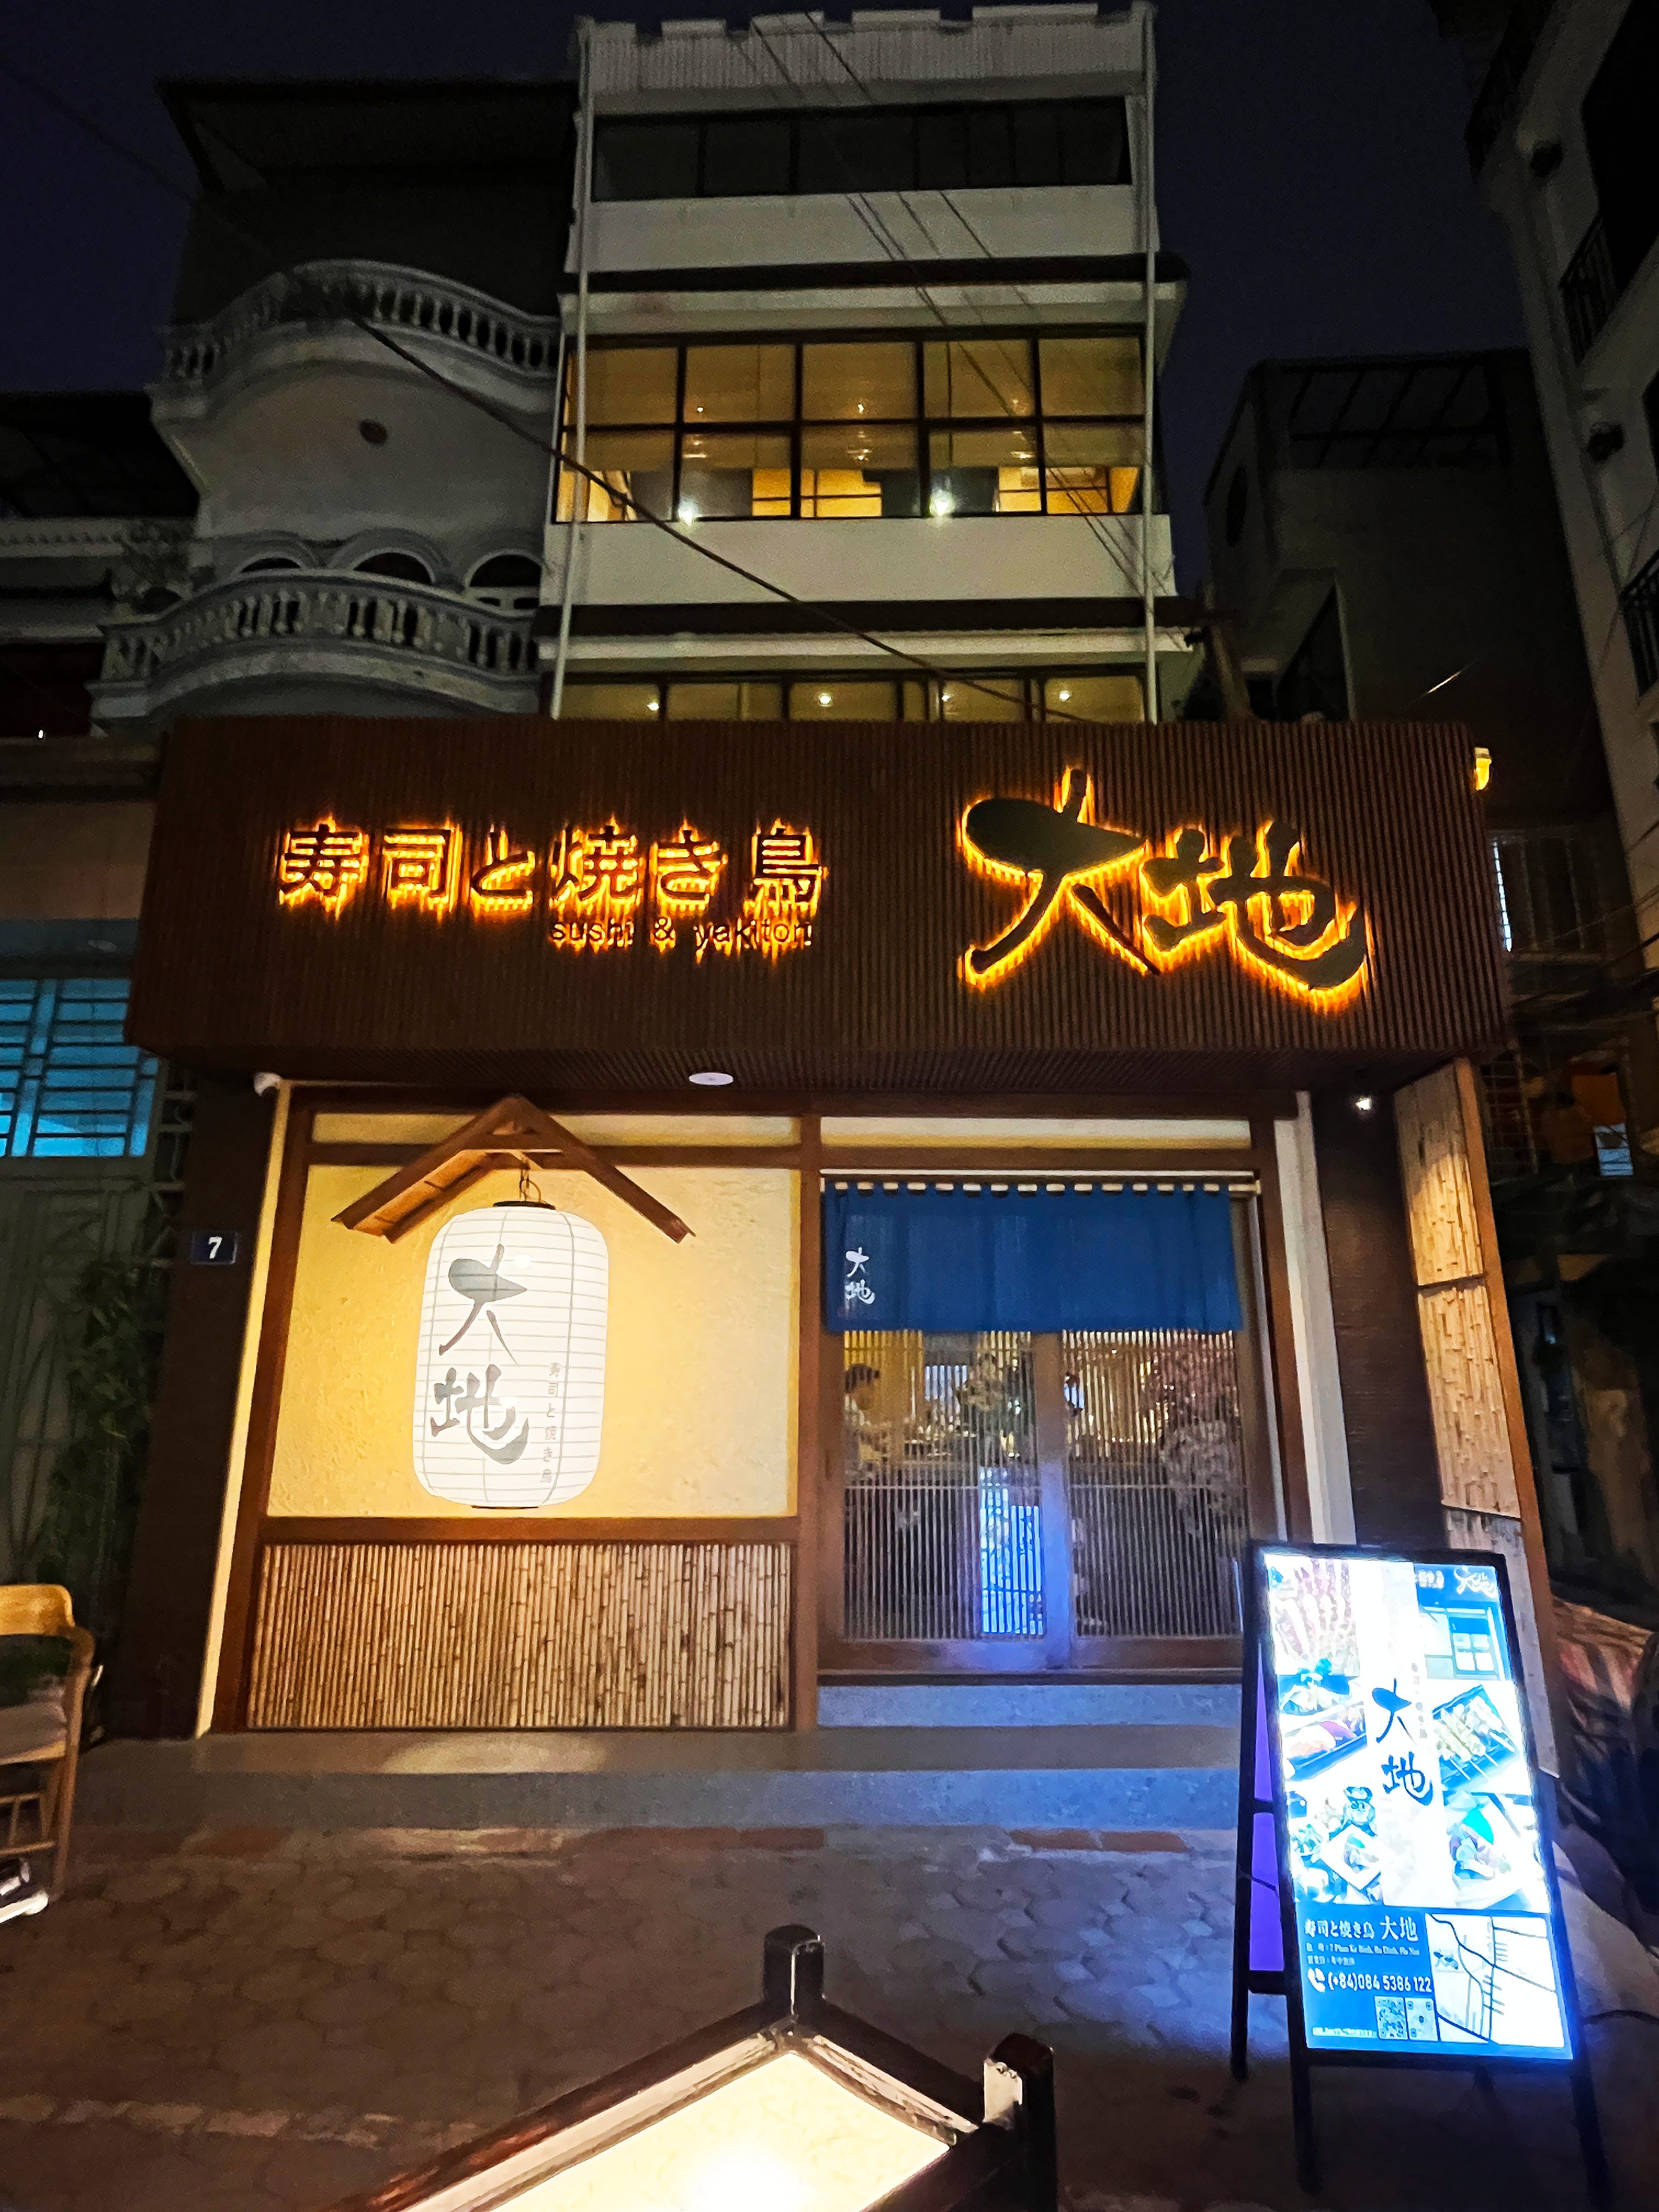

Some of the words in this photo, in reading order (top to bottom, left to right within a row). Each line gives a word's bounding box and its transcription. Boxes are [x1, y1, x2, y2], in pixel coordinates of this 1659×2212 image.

[278, 822, 822, 902] 寿司と焼き鳥
[964, 768, 1368, 993] 大地
[552, 918, 634, 945] sushi
[654, 917, 676, 944] &
[693, 918, 812, 952] yakitori
[208, 1237, 222, 1259] 7
[1372, 1678, 1434, 1805] 大地
[1380, 1915, 1419, 1942] 大地
[1383, 1974, 1411, 1991] 5386
[1413, 1976, 1432, 1993] 122
